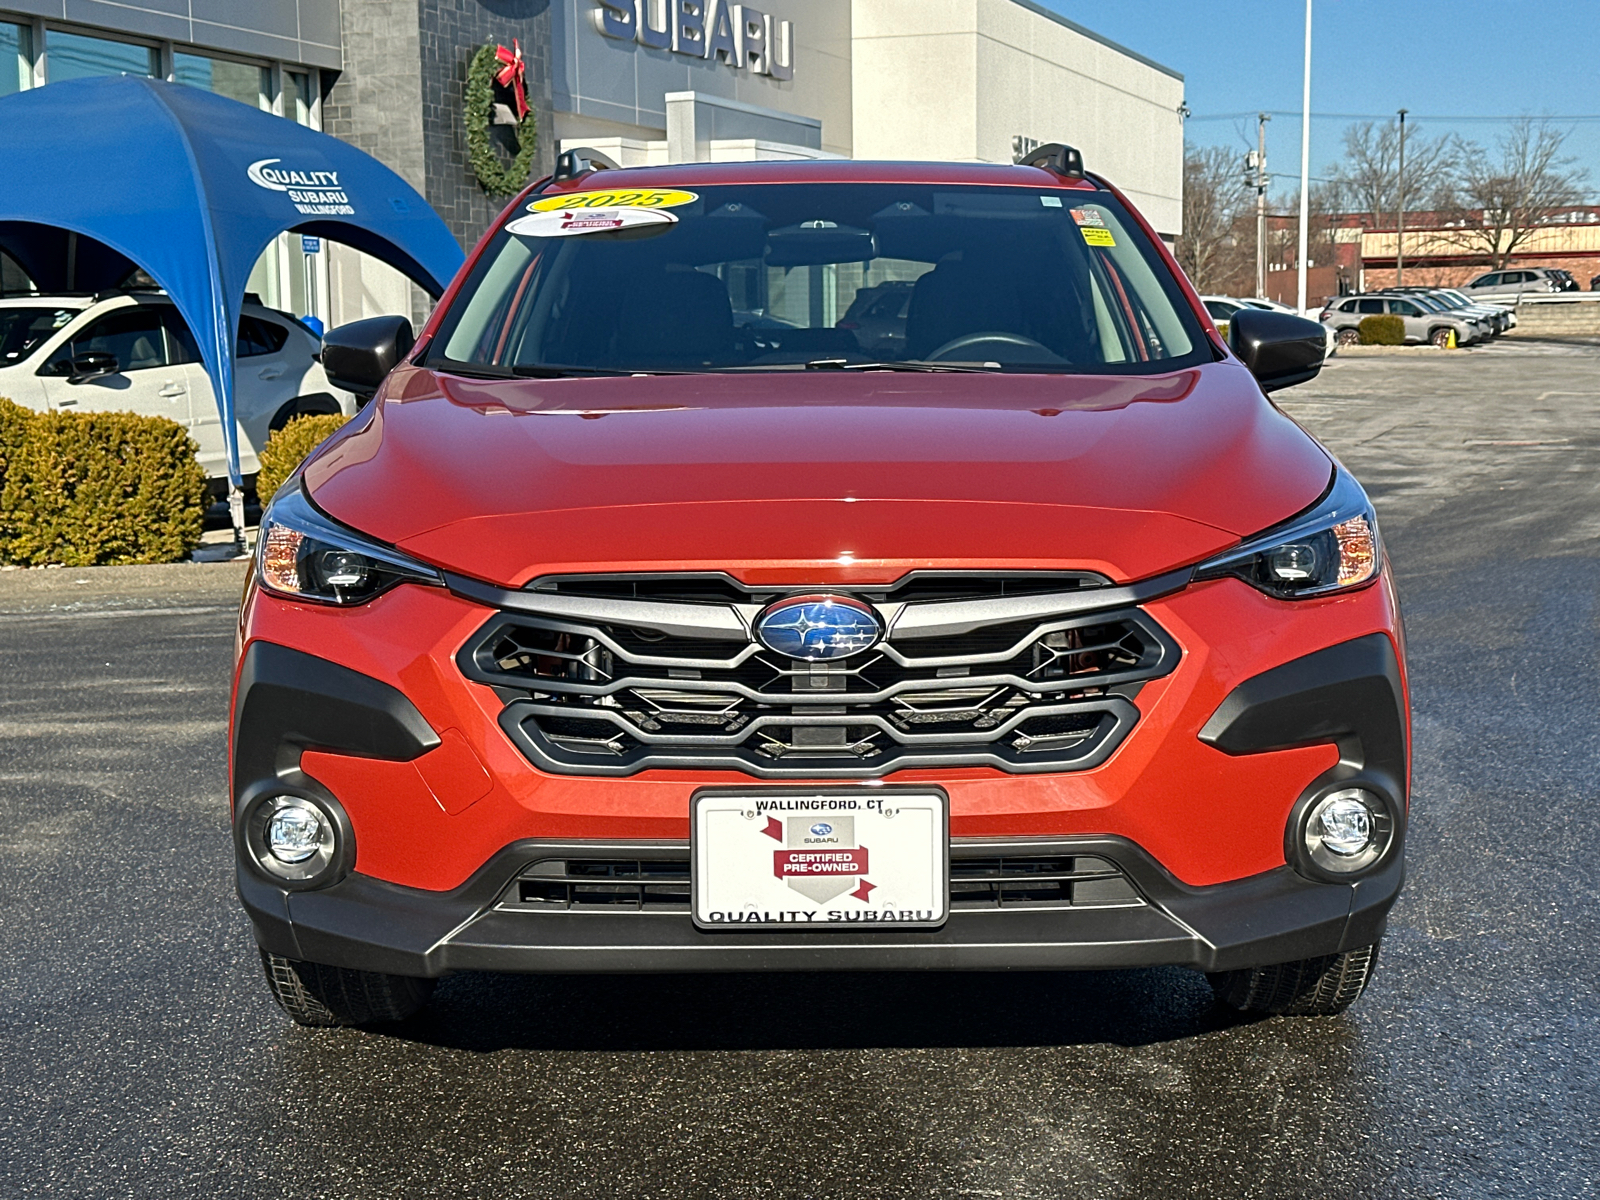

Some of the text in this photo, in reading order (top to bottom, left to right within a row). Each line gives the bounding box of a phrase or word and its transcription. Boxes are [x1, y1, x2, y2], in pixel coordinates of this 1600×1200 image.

[594, 0, 794, 81] SUBARU
[261, 168, 339, 185] QUALITY
[288, 190, 349, 204] SUBARU
[554, 193, 672, 211] 2025
[294, 203, 355, 215] WALLINGFORD
[755, 799, 884, 811] WALLINGFORD, CT
[789, 853, 853, 863] CERTIFIED
[783, 863, 859, 873] PRE-OWNED
[709, 910, 933, 923] QUALITY SUBARU
